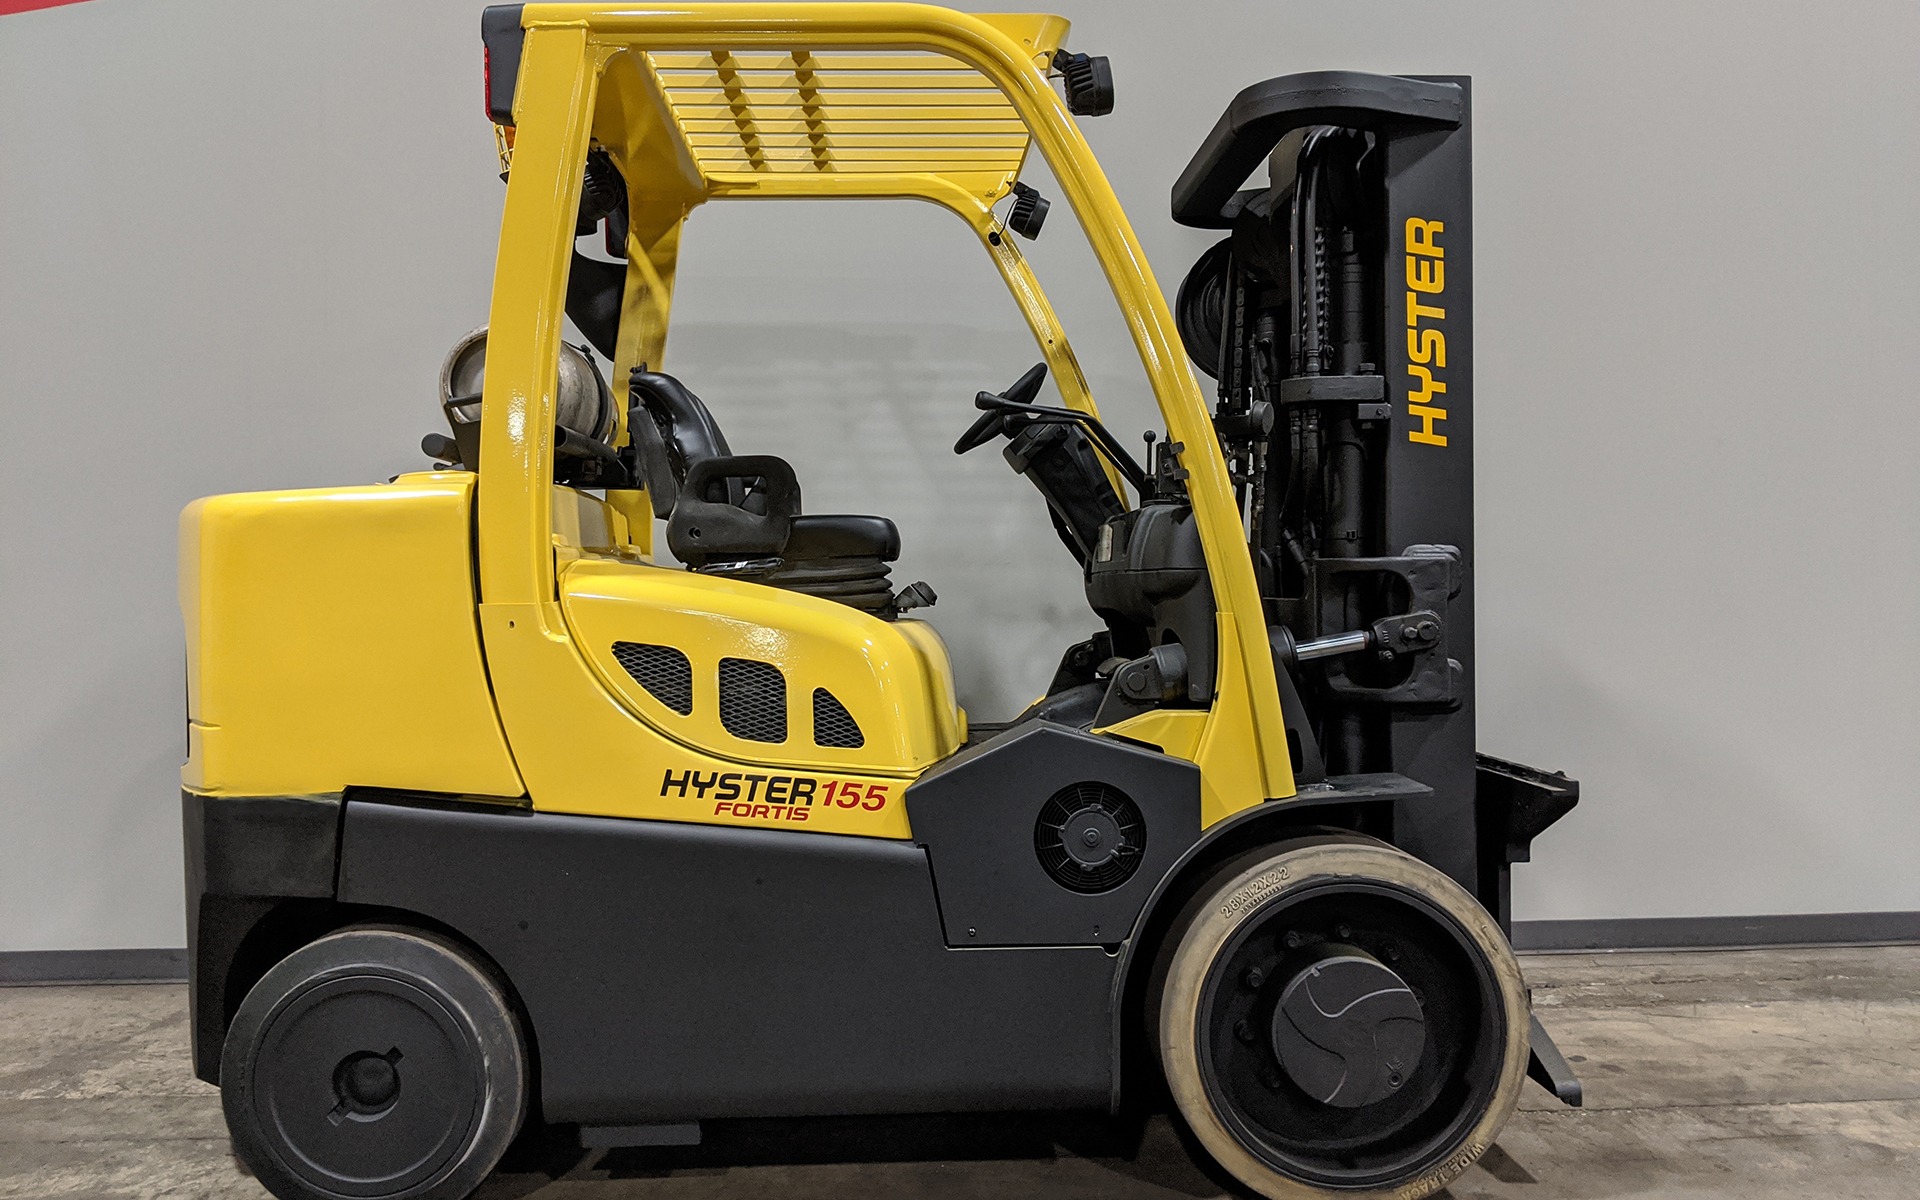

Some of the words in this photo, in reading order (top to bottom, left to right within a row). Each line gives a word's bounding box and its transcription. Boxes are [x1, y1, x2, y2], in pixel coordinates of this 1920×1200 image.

[1405, 217, 1448, 447] HYSTER
[660, 769, 817, 806] HYSTER
[821, 780, 889, 812] 155
[714, 802, 811, 821] FORTIS
[1220, 866, 1290, 918] 28X12X22
[1450, 1142, 1485, 1175] WIDE
